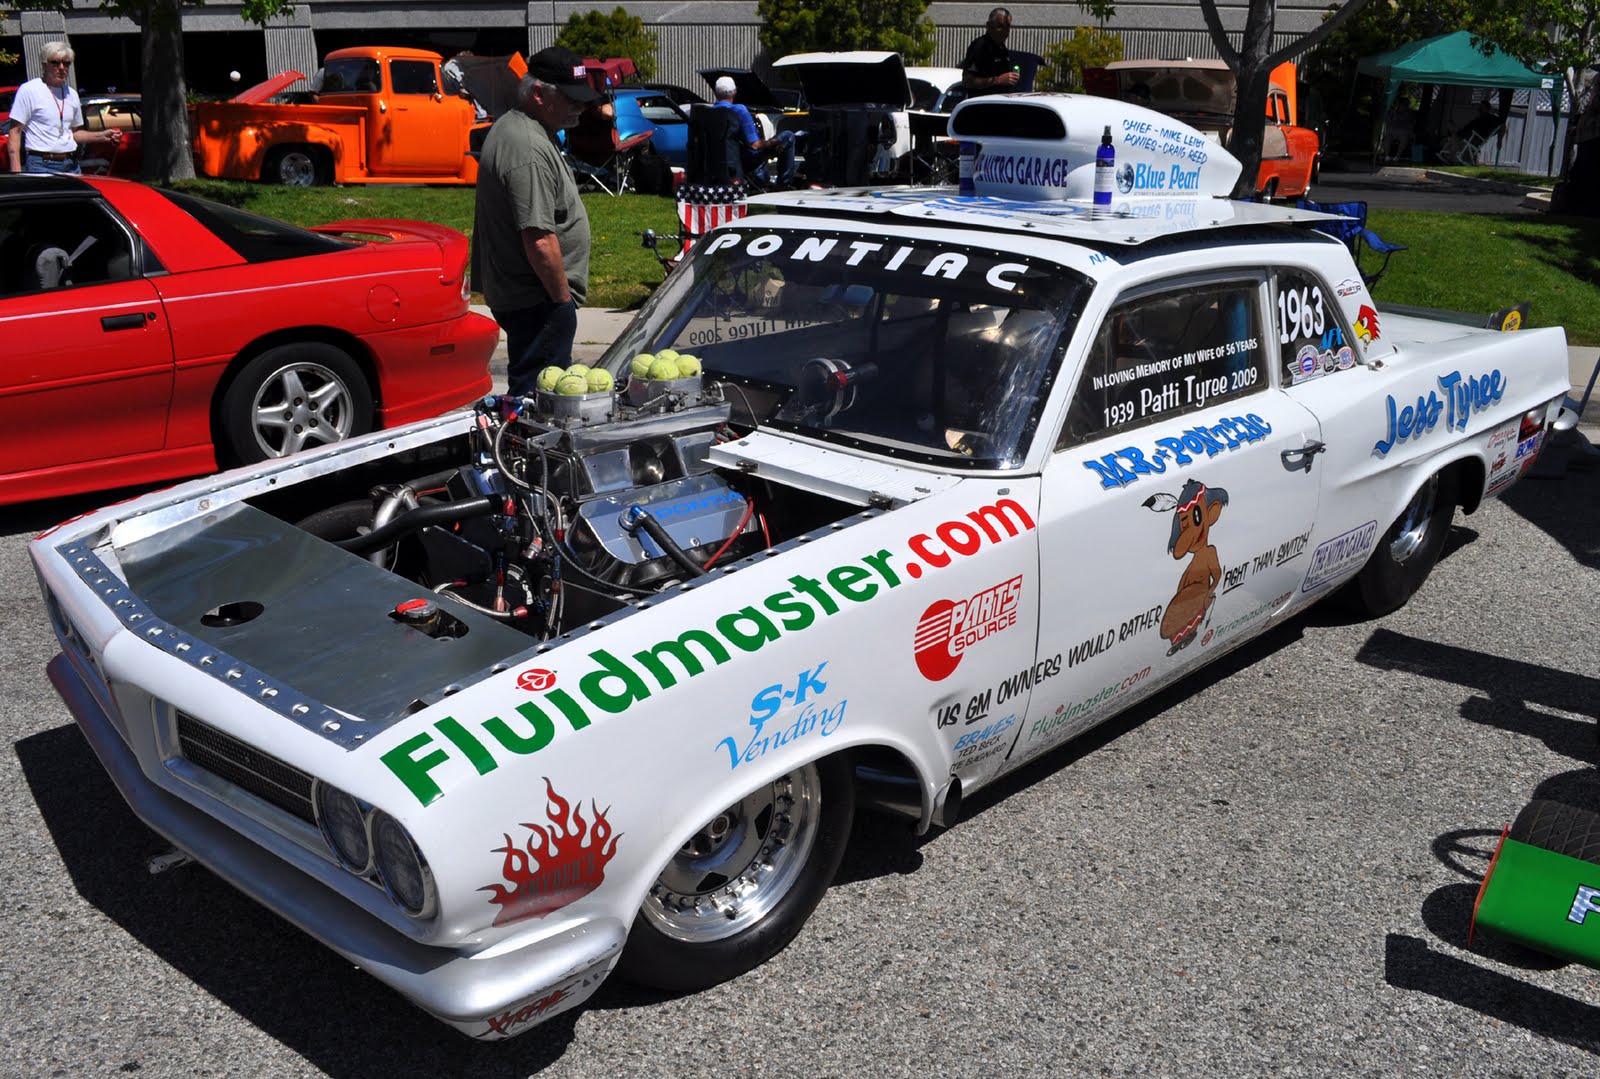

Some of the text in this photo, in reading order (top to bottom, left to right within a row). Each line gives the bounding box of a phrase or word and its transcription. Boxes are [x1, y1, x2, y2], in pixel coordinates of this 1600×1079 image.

[1122, 119, 1152, 134] CHIEF
[1160, 127, 1182, 142] MIKE
[1188, 149, 1208, 165] REED
[983, 154, 1014, 184] NITRO
[1016, 156, 1068, 188] GARAGE
[1134, 163, 1166, 190] Blue
[1169, 164, 1201, 190] Pearl
[704, 233, 1030, 291] PONTIAC
[1278, 286, 1325, 345] 1963
[1093, 338, 1258, 390] IN LOVING MEMORY OF MY WIFE OF 56 YEARS
[1104, 366, 1258, 428] 1939 Patti Tyree 2009
[1371, 369, 1507, 460] Jess Tyree
[1155, 413, 1272, 468] PONTIAC
[1252, 548, 1276, 576] THAN
[1323, 536, 1350, 568] NITRO
[1345, 525, 1375, 559] GARAGE
[949, 574, 1023, 639] PARTS
[954, 611, 1017, 652] SOURCE
[380, 498, 1036, 807] Fluidmaster.com
[937, 604, 1163, 730] US GM OWNERS WOULD RATHER
[1028, 665, 1152, 741] Fluidmaster.com
[714, 699, 848, 771] Vending
[952, 713, 1017, 751] BRAVES:
[958, 733, 1004, 758] TED BECK
